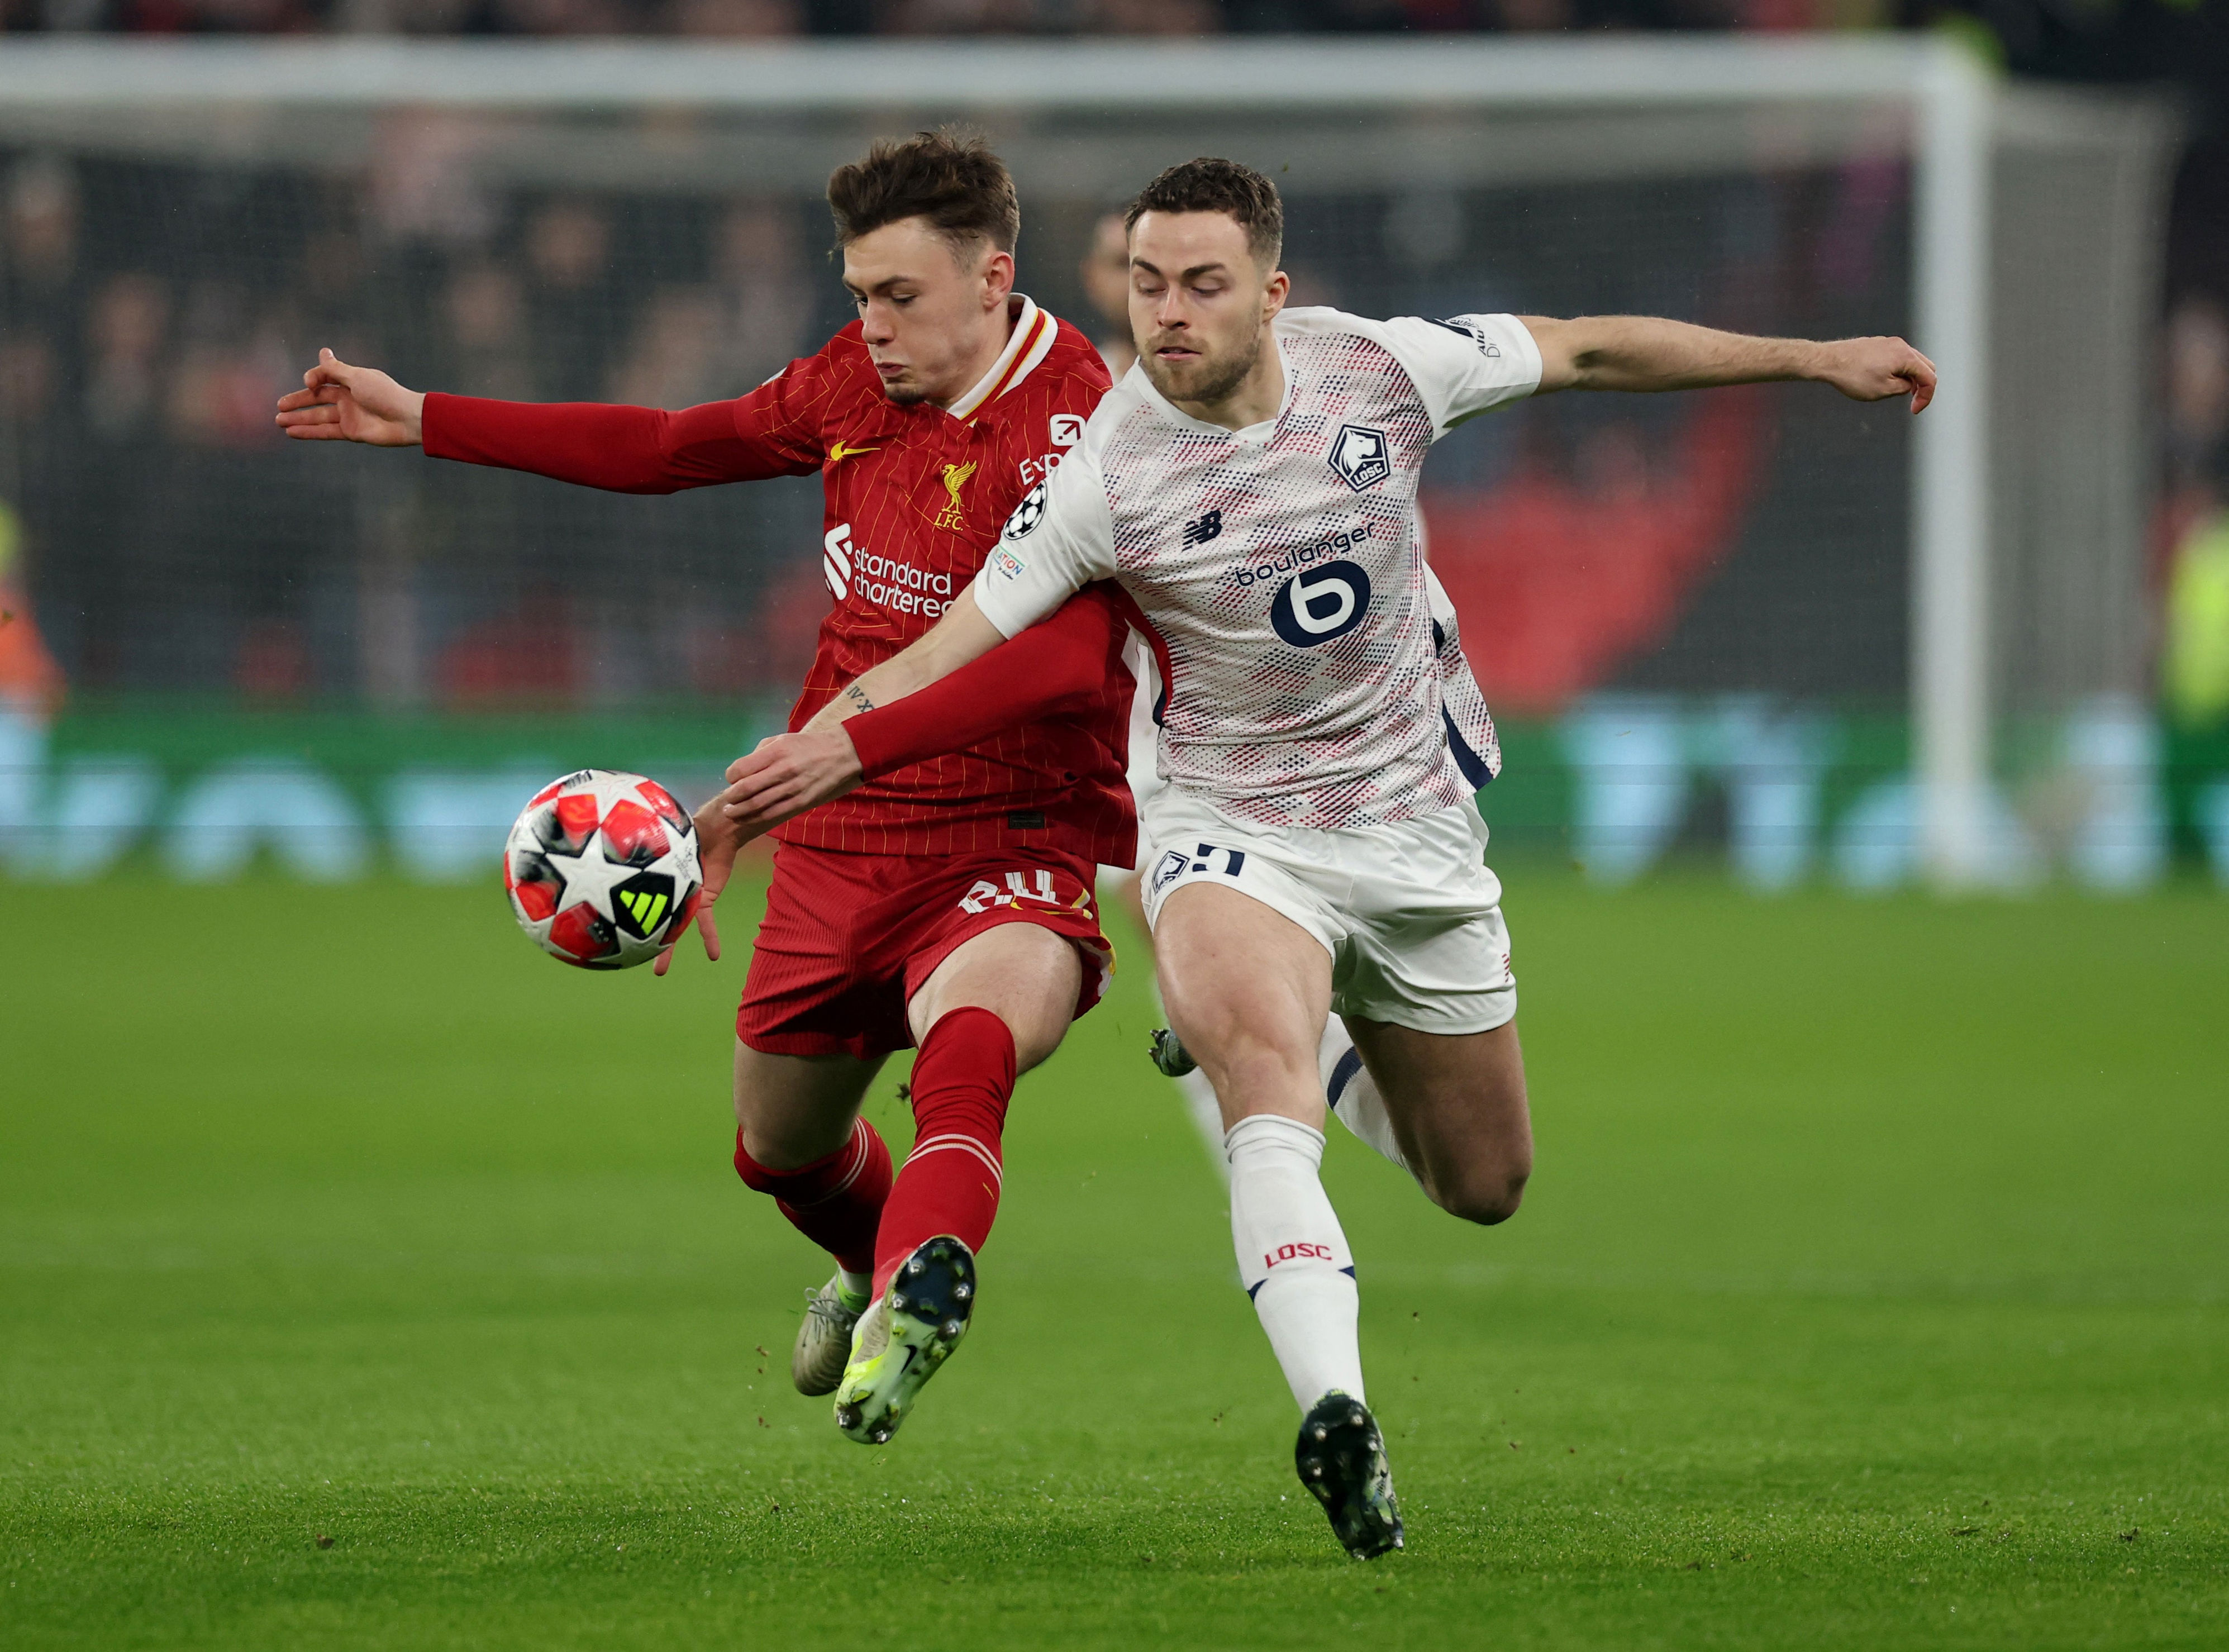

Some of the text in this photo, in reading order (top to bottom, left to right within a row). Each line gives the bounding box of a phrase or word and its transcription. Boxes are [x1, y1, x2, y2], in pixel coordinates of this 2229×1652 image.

[1018, 453, 1064, 486] Exp
[1354, 463, 1383, 484] LOSC
[854, 547, 951, 595] standard
[1236, 522, 1376, 587] boulanger
[1264, 1243, 1332, 1269] LOSC
